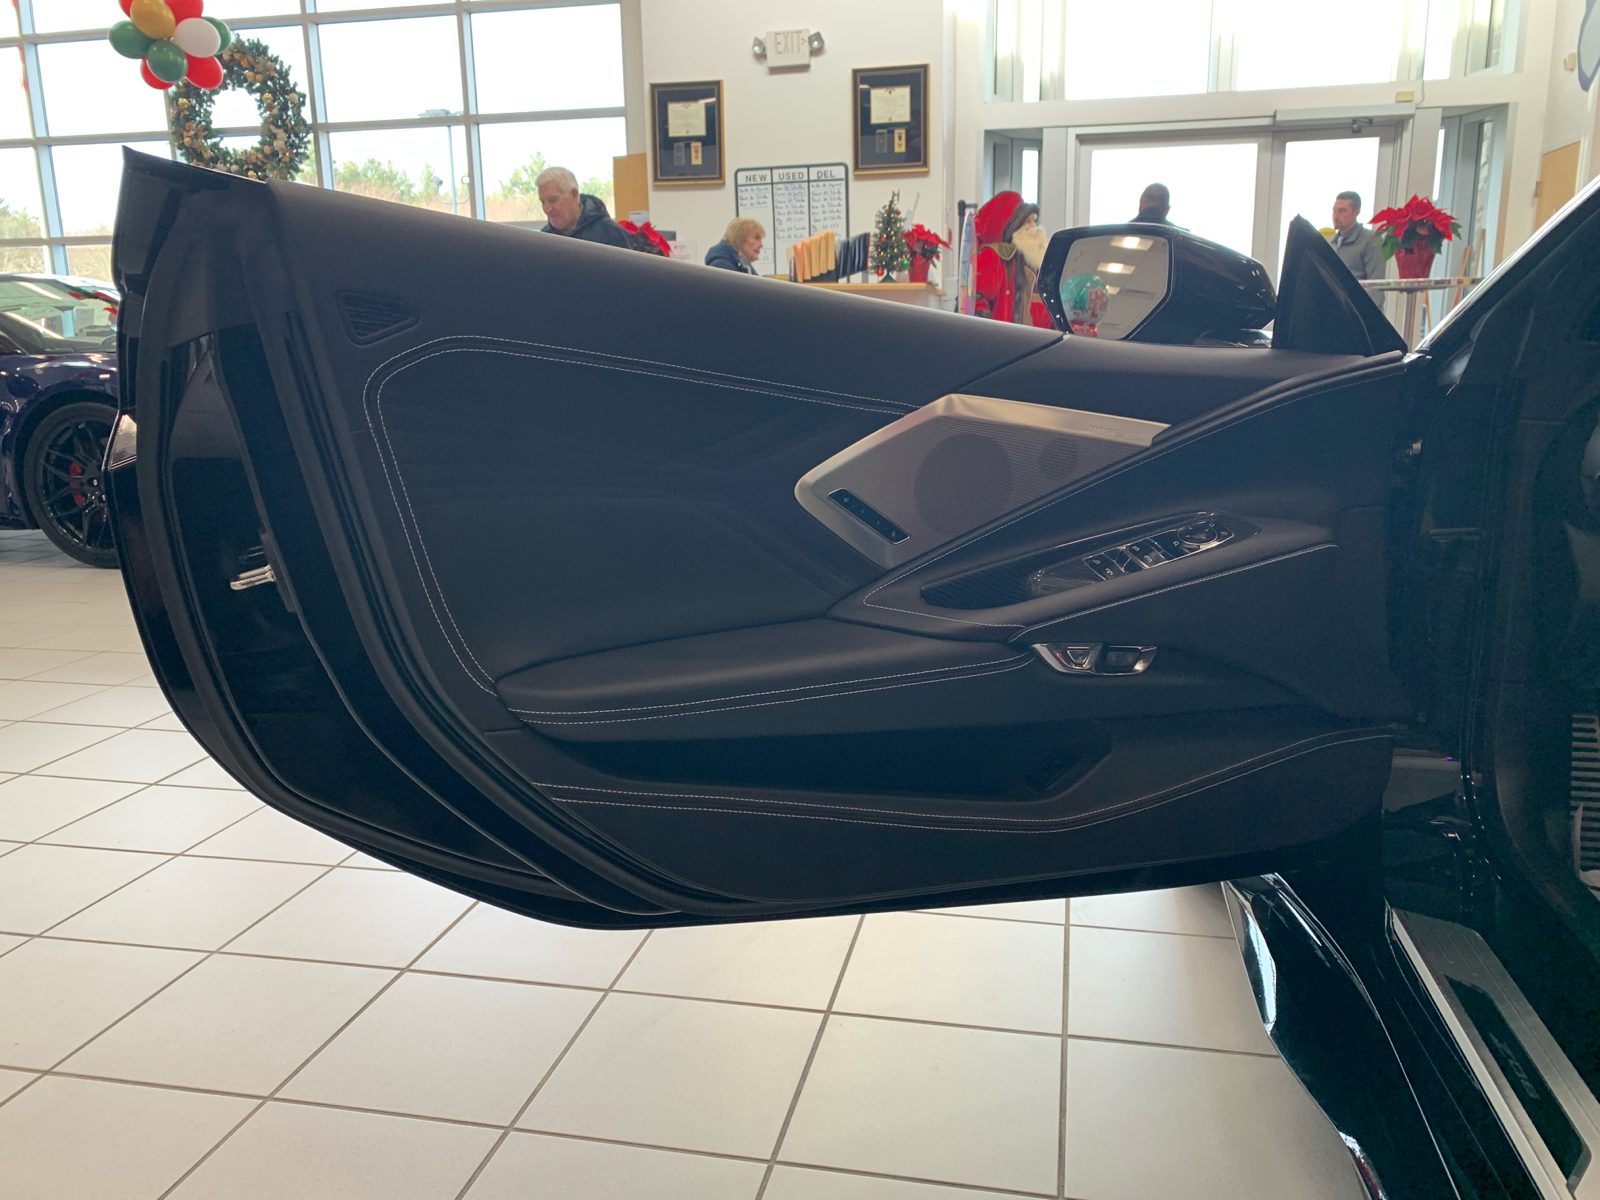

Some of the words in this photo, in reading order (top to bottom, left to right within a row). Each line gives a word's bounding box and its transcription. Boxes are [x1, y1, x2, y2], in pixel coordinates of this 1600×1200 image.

[774, 31, 802, 54] EXIT
[745, 174, 767, 183] NEW
[778, 171, 804, 180] USED
[816, 170, 835, 179] DEL
